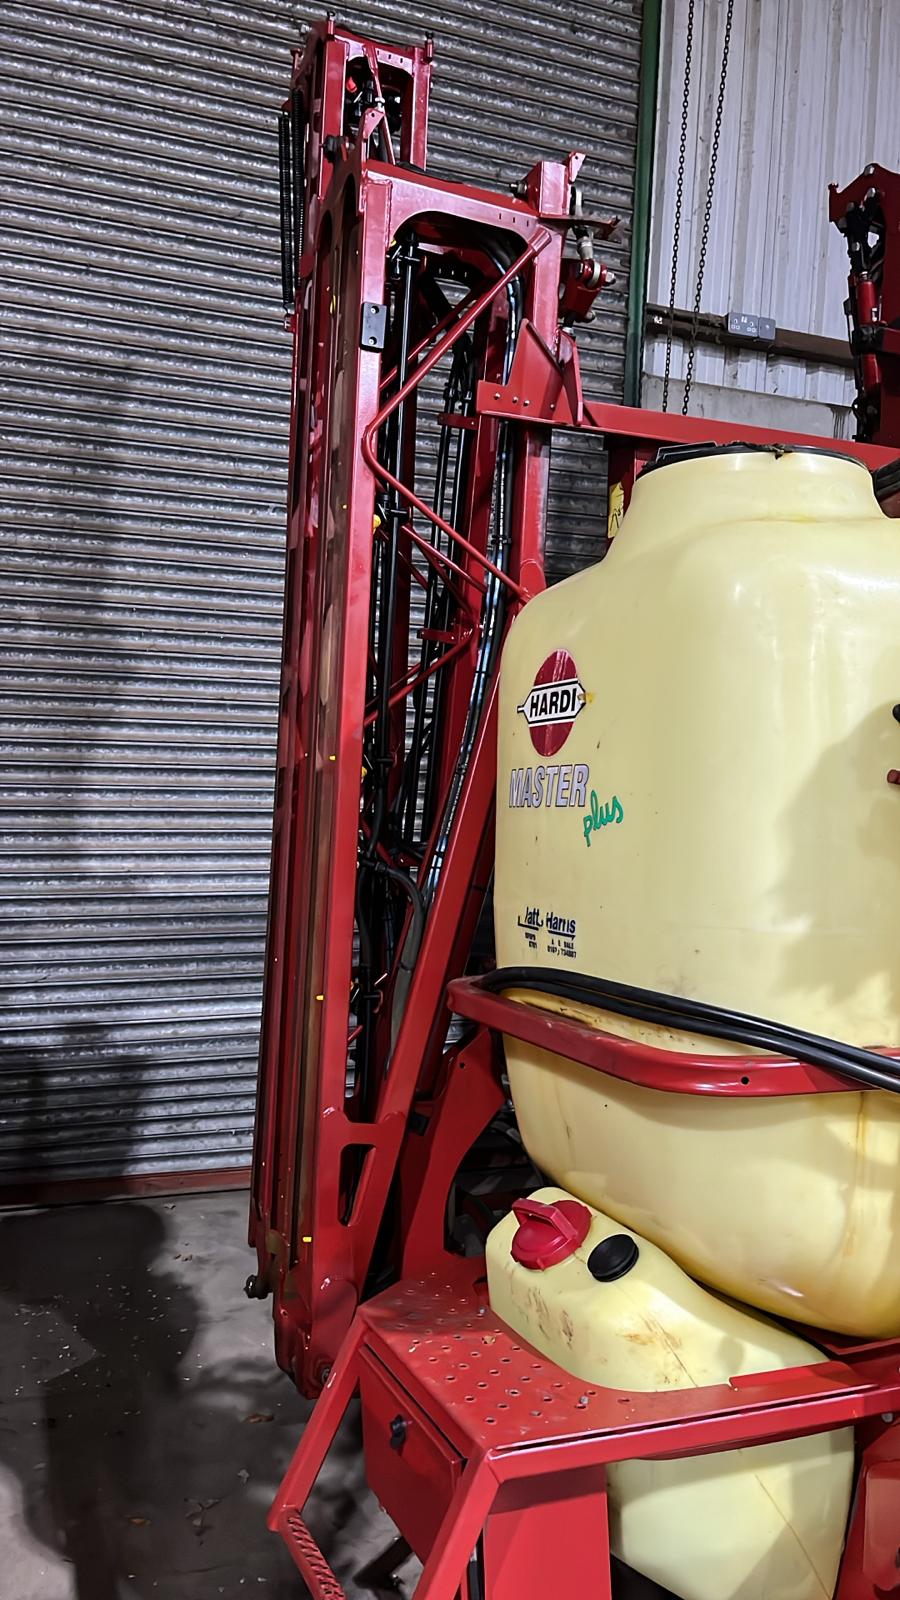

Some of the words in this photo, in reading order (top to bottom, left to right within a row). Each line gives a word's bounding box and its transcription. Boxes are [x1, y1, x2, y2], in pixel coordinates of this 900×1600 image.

[529, 688, 577, 718] HARDI
[508, 763, 590, 808] MASTER
[583, 789, 624, 847] plus
[545, 911, 576, 934] Harris
